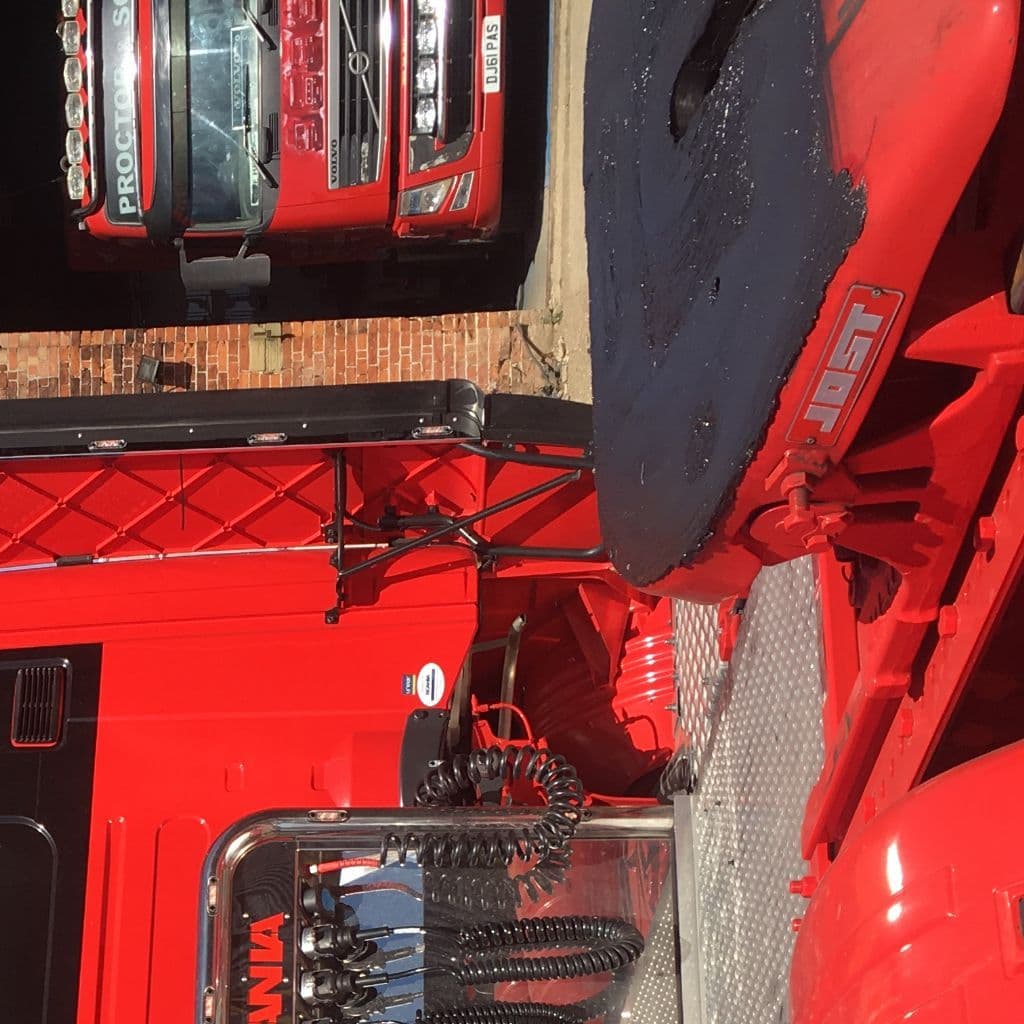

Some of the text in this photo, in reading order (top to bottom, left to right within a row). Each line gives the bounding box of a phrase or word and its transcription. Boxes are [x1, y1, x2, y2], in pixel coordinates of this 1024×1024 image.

[485, 23, 499, 84] DJ61 PAS
[330, 139, 338, 184] VOLVO
[804, 302, 884, 432] JOST
